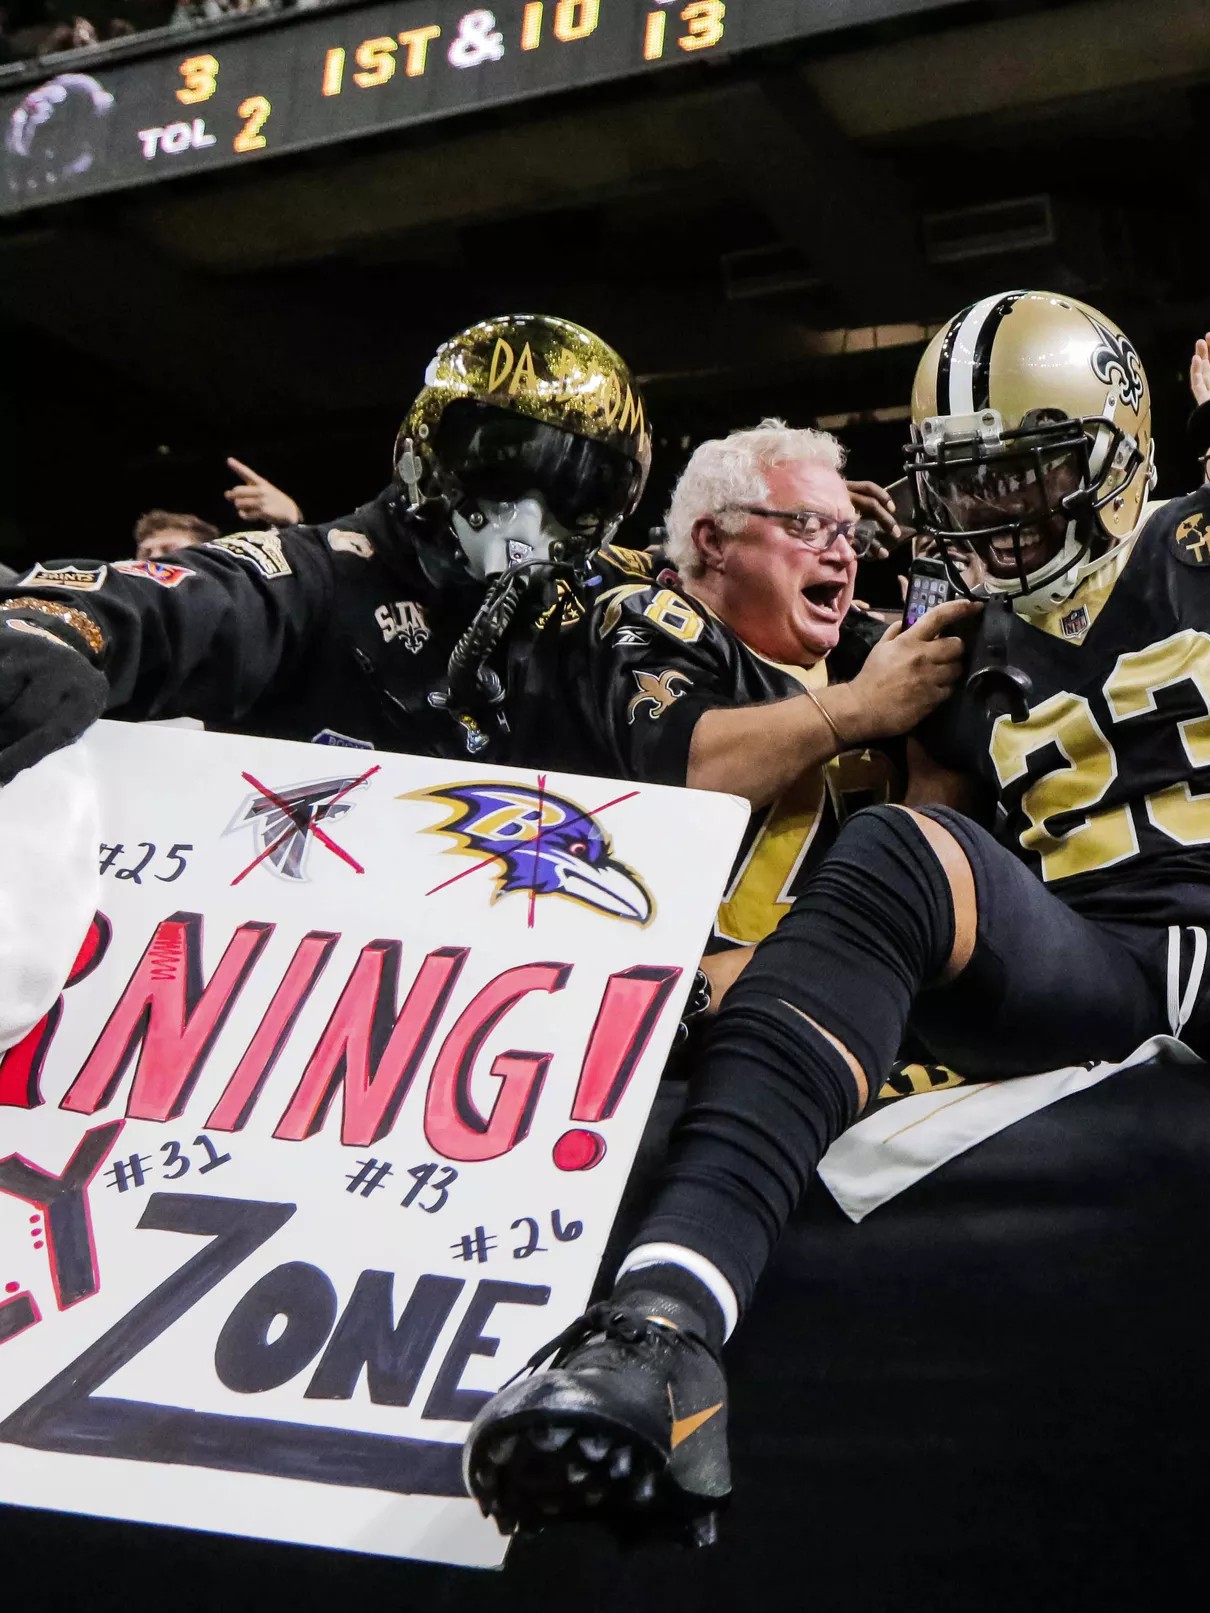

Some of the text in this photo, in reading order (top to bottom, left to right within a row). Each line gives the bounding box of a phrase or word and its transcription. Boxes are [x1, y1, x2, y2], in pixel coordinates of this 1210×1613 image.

[321, 0, 600, 96] 1ST & 10
[643, 0, 726, 61] 13
[175, 53, 220, 105] 3
[136, 95, 272, 160] TOL 2
[488, 337, 539, 396] DA
[103, 1134, 232, 1193] #31
[0, 1192, 552, 1496] ZONE
